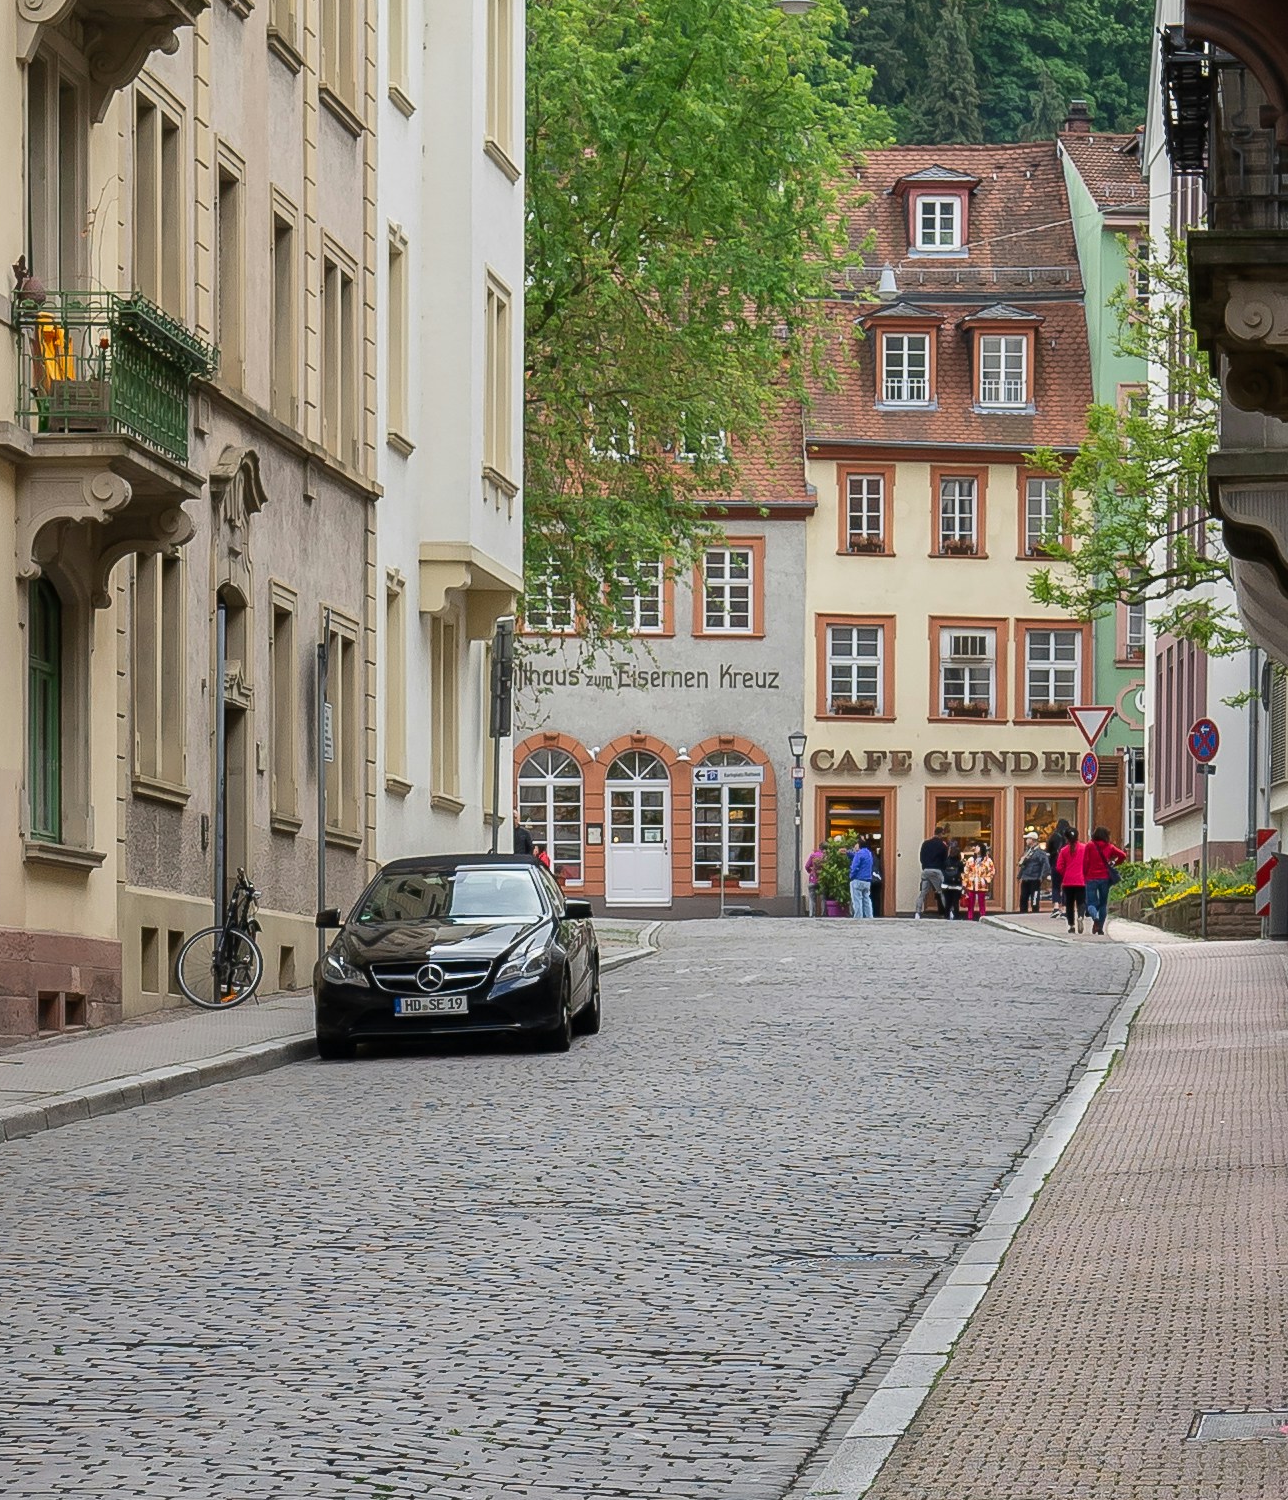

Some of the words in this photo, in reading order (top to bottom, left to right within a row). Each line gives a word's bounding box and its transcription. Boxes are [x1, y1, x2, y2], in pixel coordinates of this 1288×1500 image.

[586, 674, 613, 688] zum
[618, 662, 709, 689] Eisernen
[719, 663, 780, 689] Kreuz
[810, 749, 912, 773] CAFE
[404, 999, 422, 1012] HD
[428, 998, 446, 1011] SE
[447, 997, 463, 1010] 19
